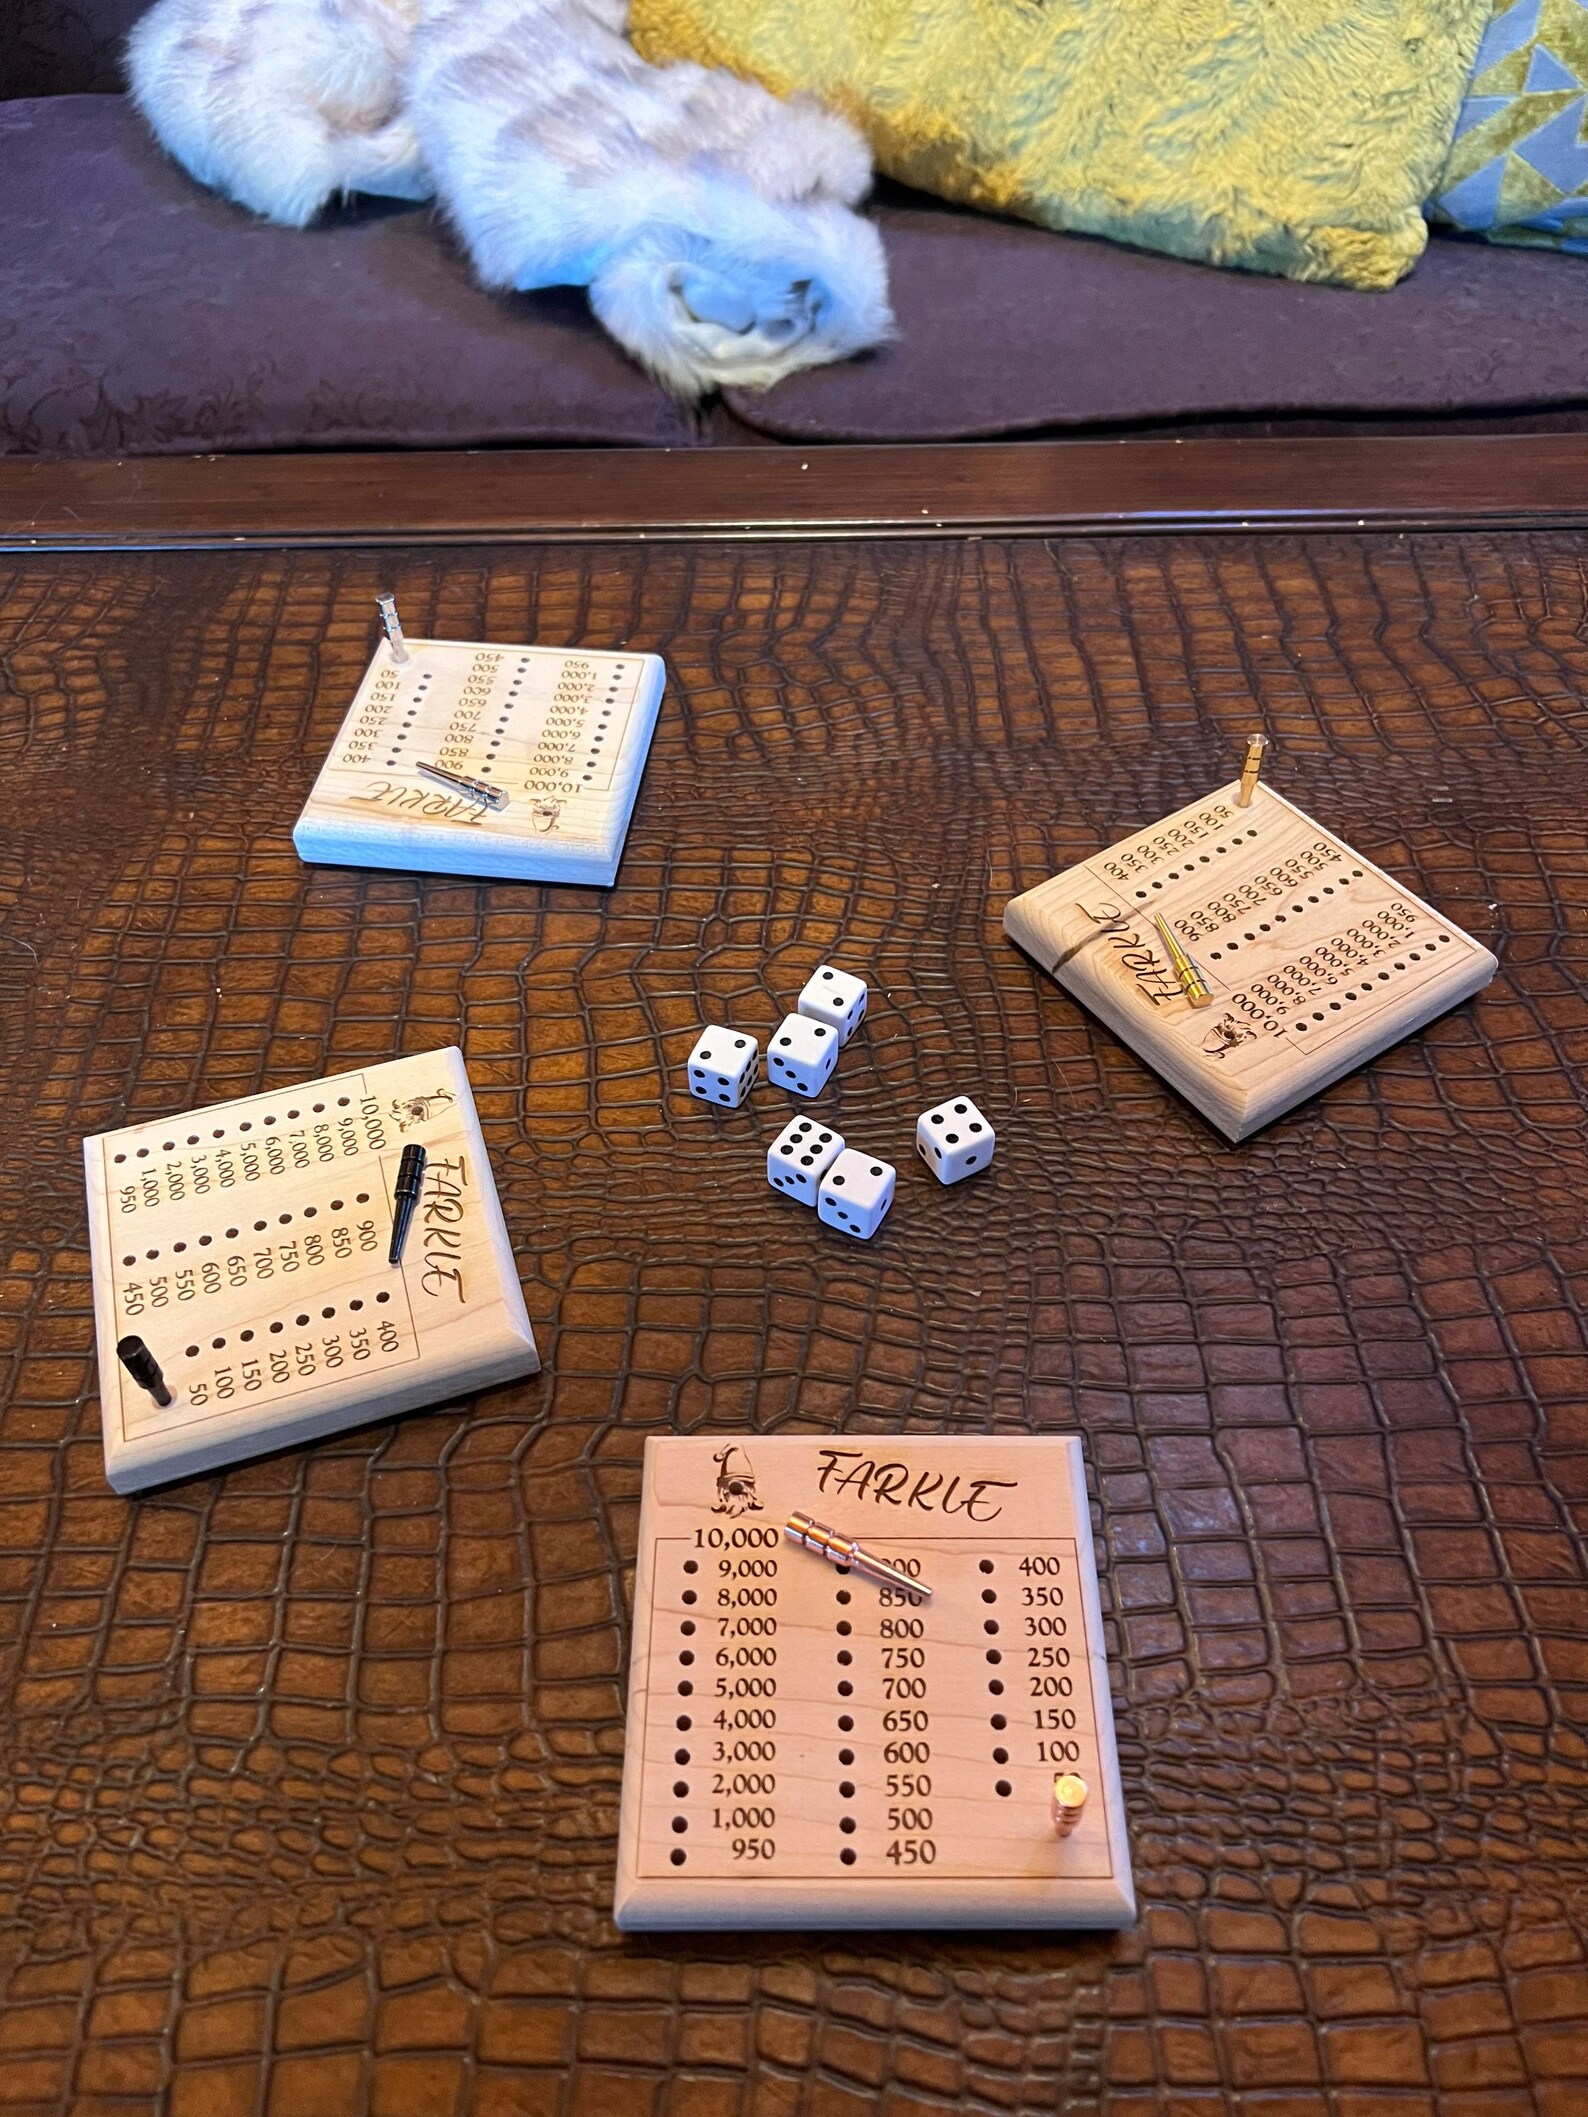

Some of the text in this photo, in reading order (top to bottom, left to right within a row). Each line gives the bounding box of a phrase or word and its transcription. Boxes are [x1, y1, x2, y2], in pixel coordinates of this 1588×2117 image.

[475, 653, 504, 662] 450
[565, 661, 589, 669] 950
[381, 670, 400, 679] 50
[472, 664, 499, 673] 500
[561, 671, 597, 680] 1,000
[375, 681, 400, 690] 100
[558, 682, 596, 692] 2,000
[370, 692, 396, 701] 150
[459, 698, 487, 707] 650
[365, 704, 393, 713] 200
[454, 710, 482, 720] 700
[550, 706, 589, 715] 4,000
[360, 716, 388, 725] 250
[450, 722, 477, 732] 750
[546, 718, 586, 728] 5,000
[354, 728, 383, 738] 300
[444, 734, 474, 744] 800
[542, 730, 581, 739] 6,000
[349, 741, 378, 750] 350
[440, 747, 469, 757] 850
[538, 742, 576, 752] 7,000
[342, 754, 371, 763] 400
[435, 760, 464, 770] 900
[534, 754, 574, 764] 8,000
[530, 767, 569, 777] 9,000
[524, 780, 581, 793] 10,000
[1199, 812, 1225, 831] 100
[1214, 805, 1234, 819] 50
[1168, 828, 1195, 848] 200
[1184, 821, 1210, 839] 150
[1137, 845, 1164, 864] 300
[1153, 837, 1180, 855] 250
[1313, 842, 1342, 862] 450
[1104, 862, 1129, 880] 400
[1121, 853, 1148, 873] 350
[1285, 859, 1314, 879] 550
[1300, 851, 1328, 870] 500
[1254, 876, 1282, 895] 650
[1270, 868, 1298, 887] 600
[1223, 893, 1251, 914] 750
[1239, 885, 1267, 906] 700
[1190, 911, 1219, 932] 850
[1207, 902, 1236, 922] 800
[1391, 903, 1419, 922] 950
[1174, 920, 1203, 941] 900
[1362, 920, 1402, 948] 2,000
[1377, 911, 1416, 938] 1,000
[1331, 938, 1369, 966] 4,000
[1346, 929, 1386, 957] 3,000
[1075, 903, 1183, 1005] FARKLE
[1315, 947, 1355, 976] 5,000
[1283, 965, 1322, 995] 7,000
[1299, 956, 1338, 985] 6,000
[1251, 984, 1290, 1015] 9,000
[1267, 974, 1306, 1005] 8,000
[1232, 993, 1288, 1038] 10,000
[360, 1096, 386, 1150] 10,000
[314, 1124, 334, 1162] 8,000
[337, 1118, 359, 1156] 9,000
[265, 1137, 285, 1175] 6,000
[289, 1130, 310, 1168] 7,000
[215, 1149, 235, 1187] 4,000
[240, 1142, 260, 1181] 5,000
[165, 1161, 185, 1200] 2,000
[190, 1155, 210, 1194] 3,000
[140, 1168, 160, 1207] 1,000
[120, 1186, 137, 1213] 950
[357, 1220, 378, 1251] 900
[421, 1156, 468, 1303] FARKLE
[305, 1235, 325, 1266] 800
[332, 1227, 352, 1258] 850
[253, 1248, 274, 1279] 700
[279, 1241, 300, 1272] 750
[202, 1262, 221, 1293] 600
[227, 1256, 247, 1286] 650
[150, 1276, 169, 1307] 500
[175, 1269, 195, 1300] 550
[123, 1283, 145, 1315] 450
[349, 1327, 371, 1360] 350
[377, 1321, 399, 1352] 400
[295, 1343, 316, 1376] 250
[322, 1335, 343, 1368] 300
[241, 1359, 262, 1391] 150
[270, 1350, 290, 1383] 200
[214, 1367, 235, 1399] 100
[189, 1384, 208, 1406] 50
[816, 1449, 1018, 1522] FARKLE
[693, 1527, 779, 1550] 10,000
[718, 1559, 778, 1580] 9,000
[881, 1558, 921, 1578] 00
[1018, 1557, 1060, 1576] 400
[716, 1588, 777, 1609] 8,000
[878, 1588, 922, 1607] 850
[1020, 1586, 1064, 1607] 350
[717, 1617, 777, 1638] 7,000
[879, 1618, 924, 1639] 800
[1024, 1616, 1067, 1636] 300
[715, 1647, 777, 1668] 6,000
[881, 1647, 925, 1668] 750
[1027, 1647, 1070, 1668] 250
[714, 1677, 777, 1698] 5,000
[882, 1677, 927, 1698] 700
[1030, 1676, 1073, 1697] 200
[713, 1708, 777, 1731] 4,000
[882, 1709, 929, 1732] 650
[1033, 1708, 1077, 1729] 150
[712, 1740, 776, 1764] 3,000
[883, 1741, 930, 1763] 600
[1037, 1740, 1080, 1762] 100
[711, 1773, 776, 1796] 2,000
[885, 1774, 932, 1797] 550
[711, 1807, 776, 1830] 1,000
[887, 1807, 933, 1830] 500
[731, 1838, 776, 1860] 950
[886, 1839, 936, 1864] 450
